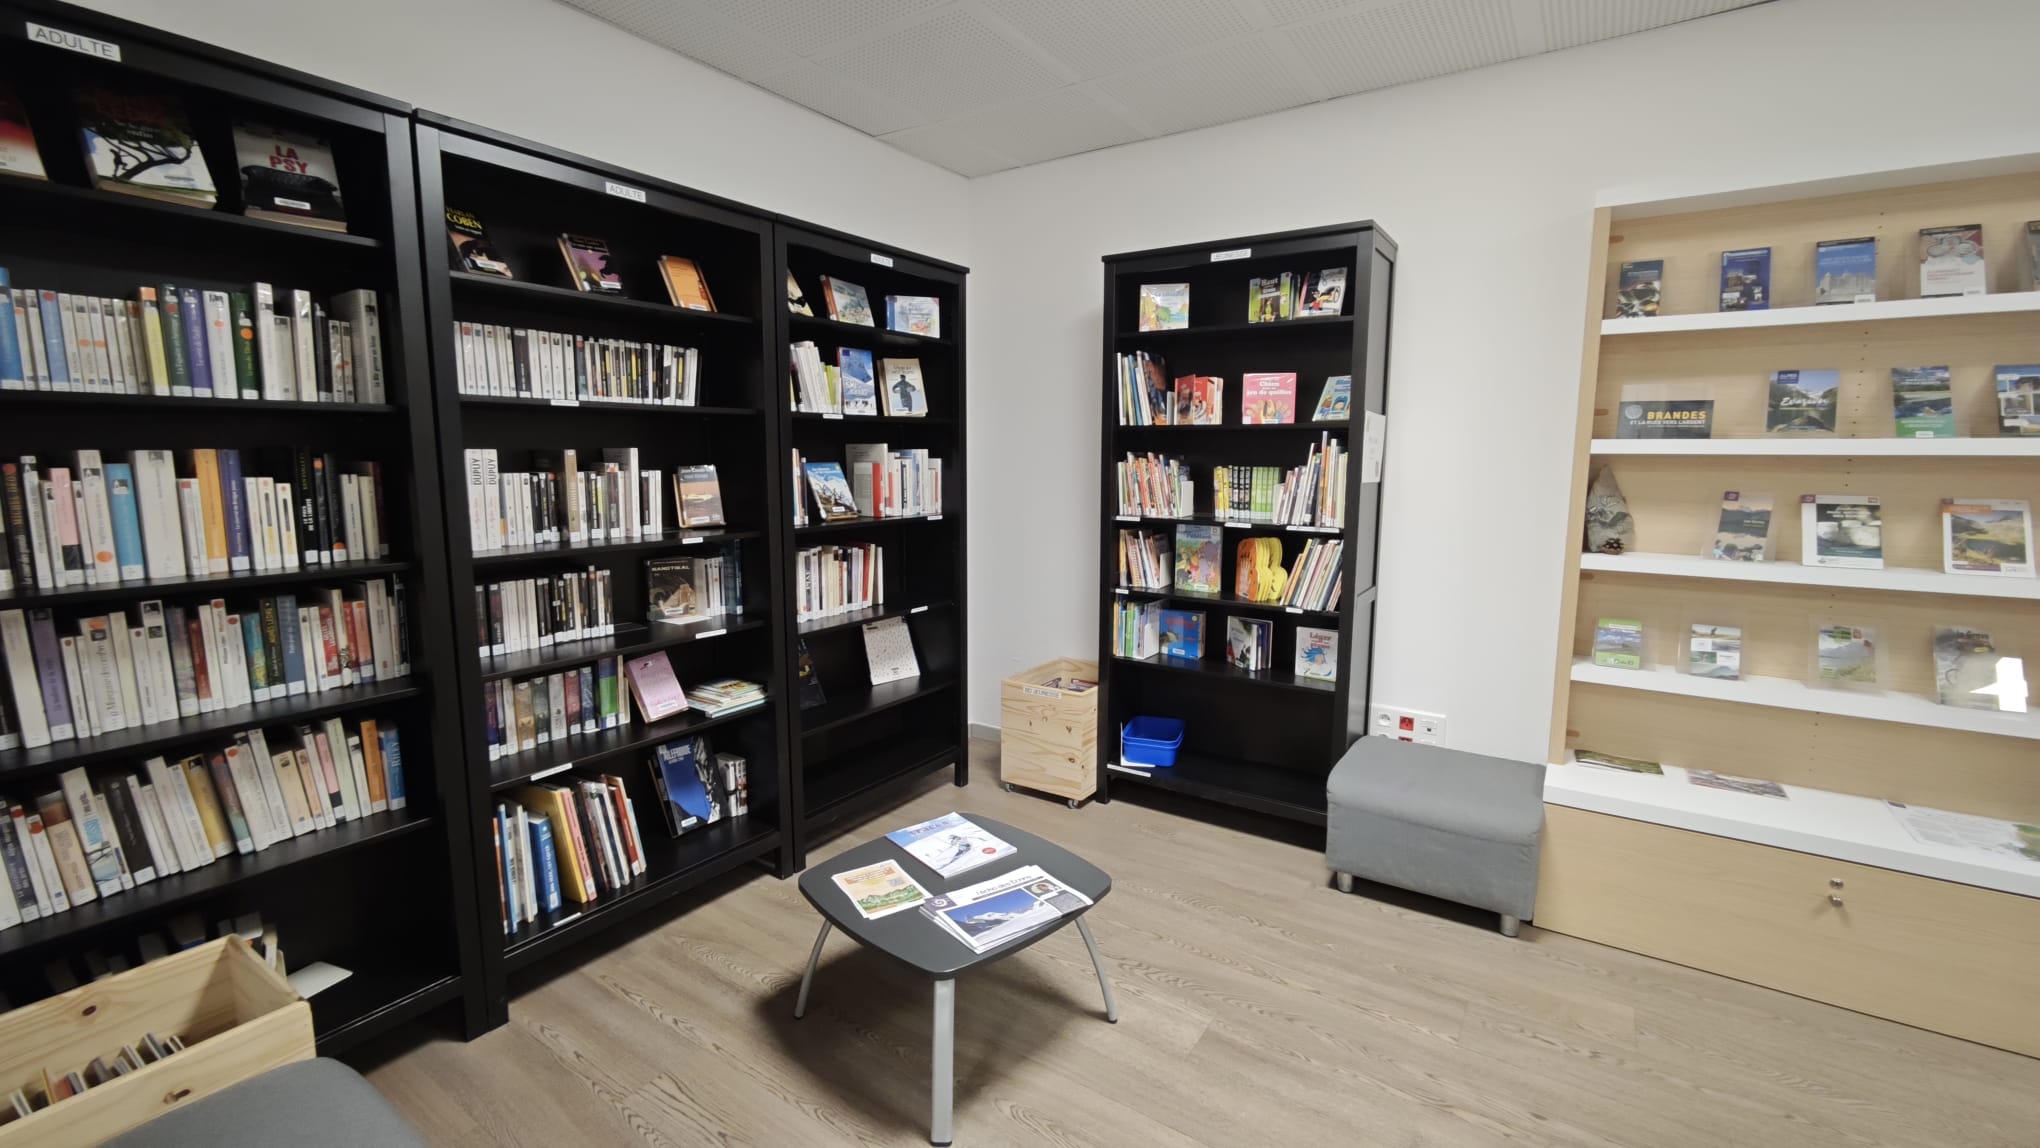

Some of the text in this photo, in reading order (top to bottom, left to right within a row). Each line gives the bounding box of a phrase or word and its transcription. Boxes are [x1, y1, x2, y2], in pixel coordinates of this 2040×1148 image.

[35, 26, 115, 59] ADULTE
[275, 144, 299, 160] LA
[269, 155, 308, 174] PSY
[609, 185, 643, 201] ADULTE
[446, 213, 483, 231] COBEN
[1647, 410, 1707, 420] BRANDES
[472, 458, 482, 486] DUPUY
[487, 458, 497, 486] DUPUY
[391, 741, 401, 767] RILEY
